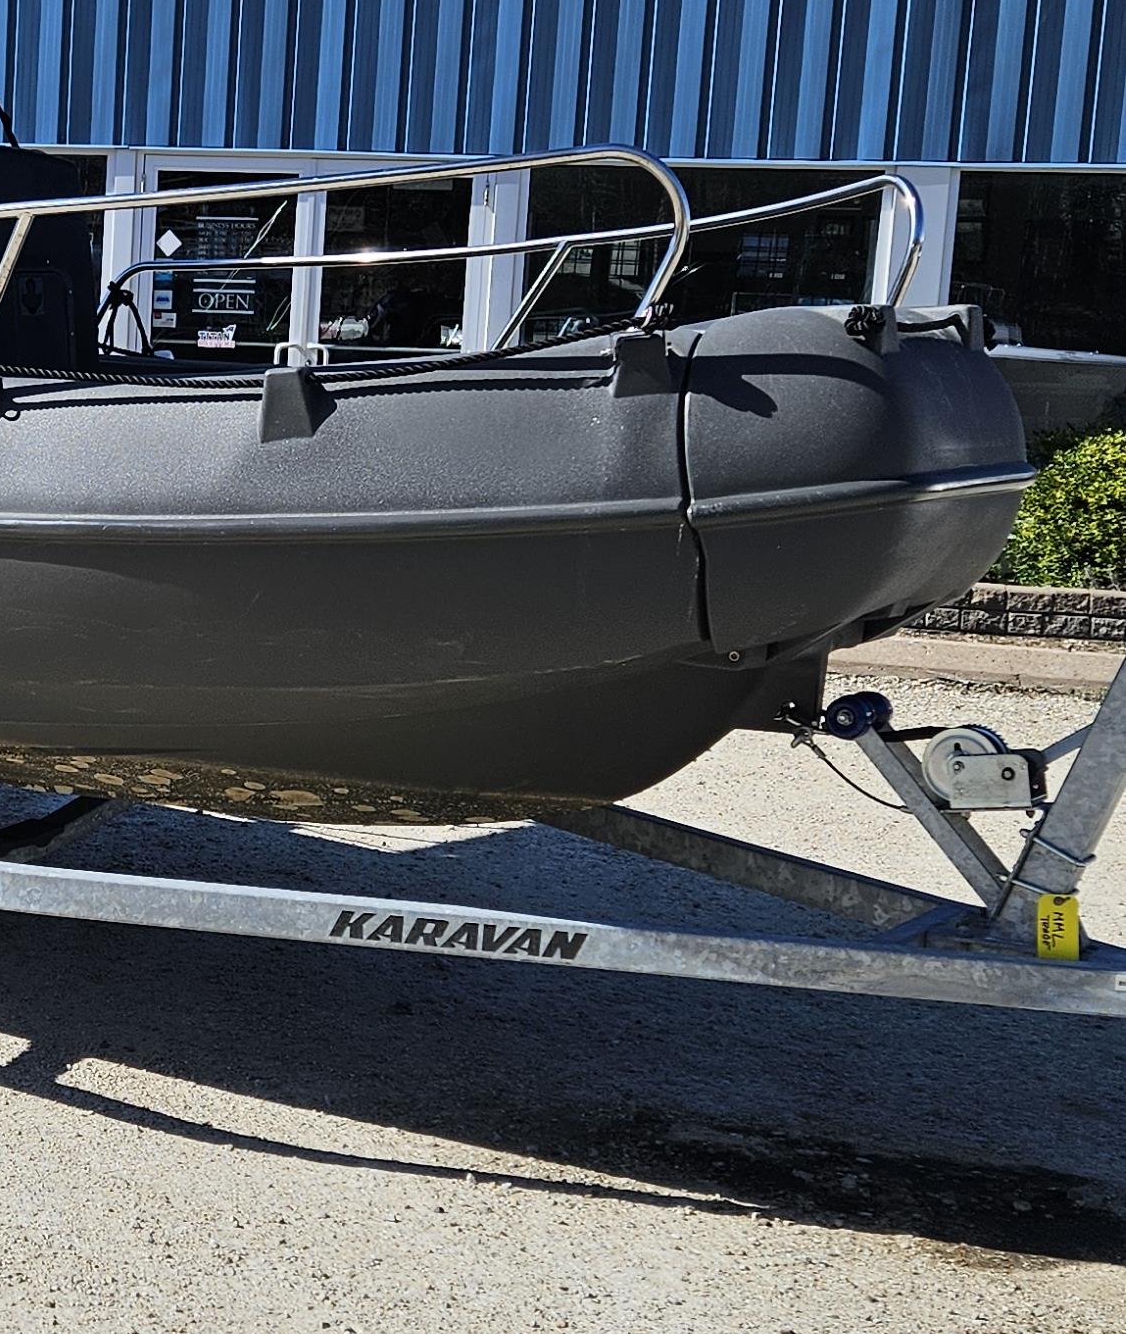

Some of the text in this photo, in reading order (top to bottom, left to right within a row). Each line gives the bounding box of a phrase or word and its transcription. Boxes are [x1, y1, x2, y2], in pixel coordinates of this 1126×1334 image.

[198, 293, 249, 309] OPEN
[198, 331, 230, 340] TITAN
[329, 910, 588, 960] KARAVAN
